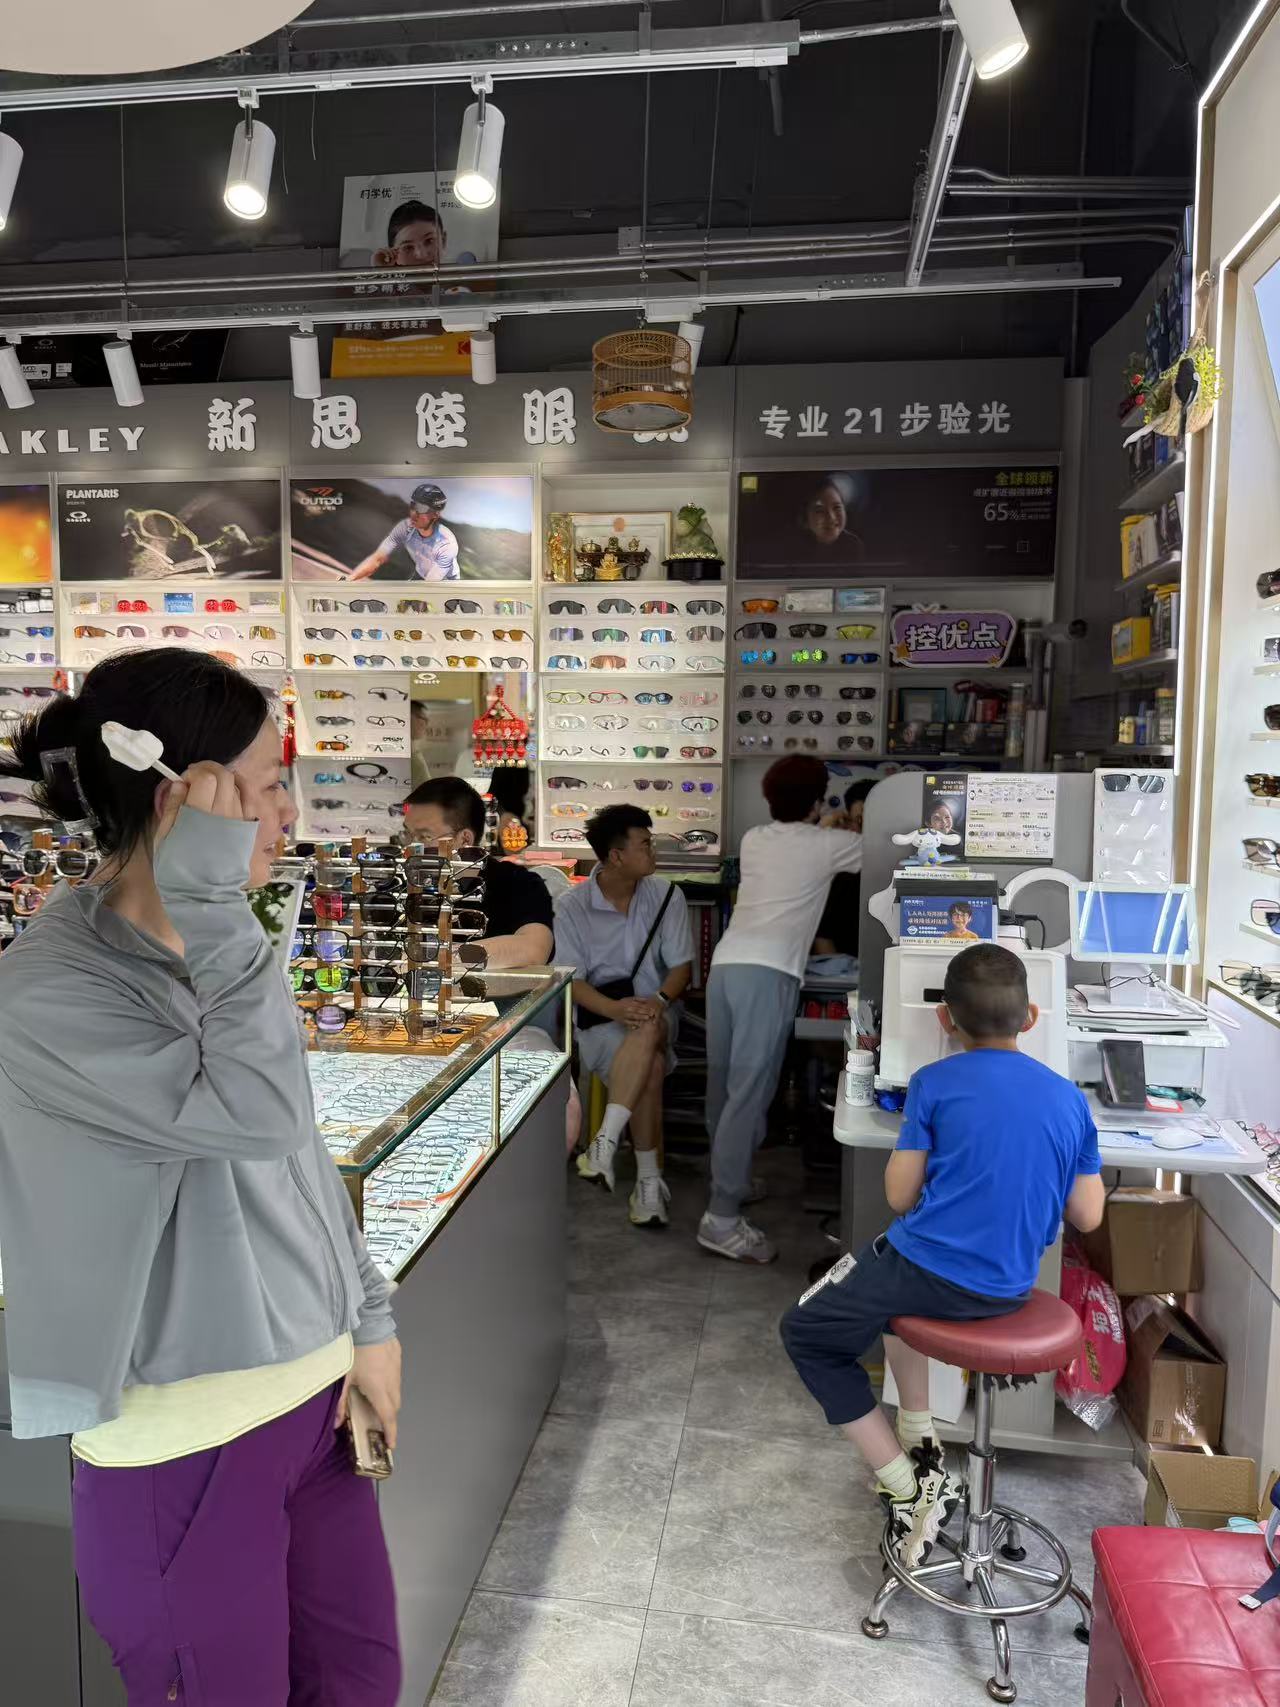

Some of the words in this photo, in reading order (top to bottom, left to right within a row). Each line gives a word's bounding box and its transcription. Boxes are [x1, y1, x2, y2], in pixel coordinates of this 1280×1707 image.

[66, 489, 119, 500] PLANTARIS
[906, 622, 1001, 651] 控优点
